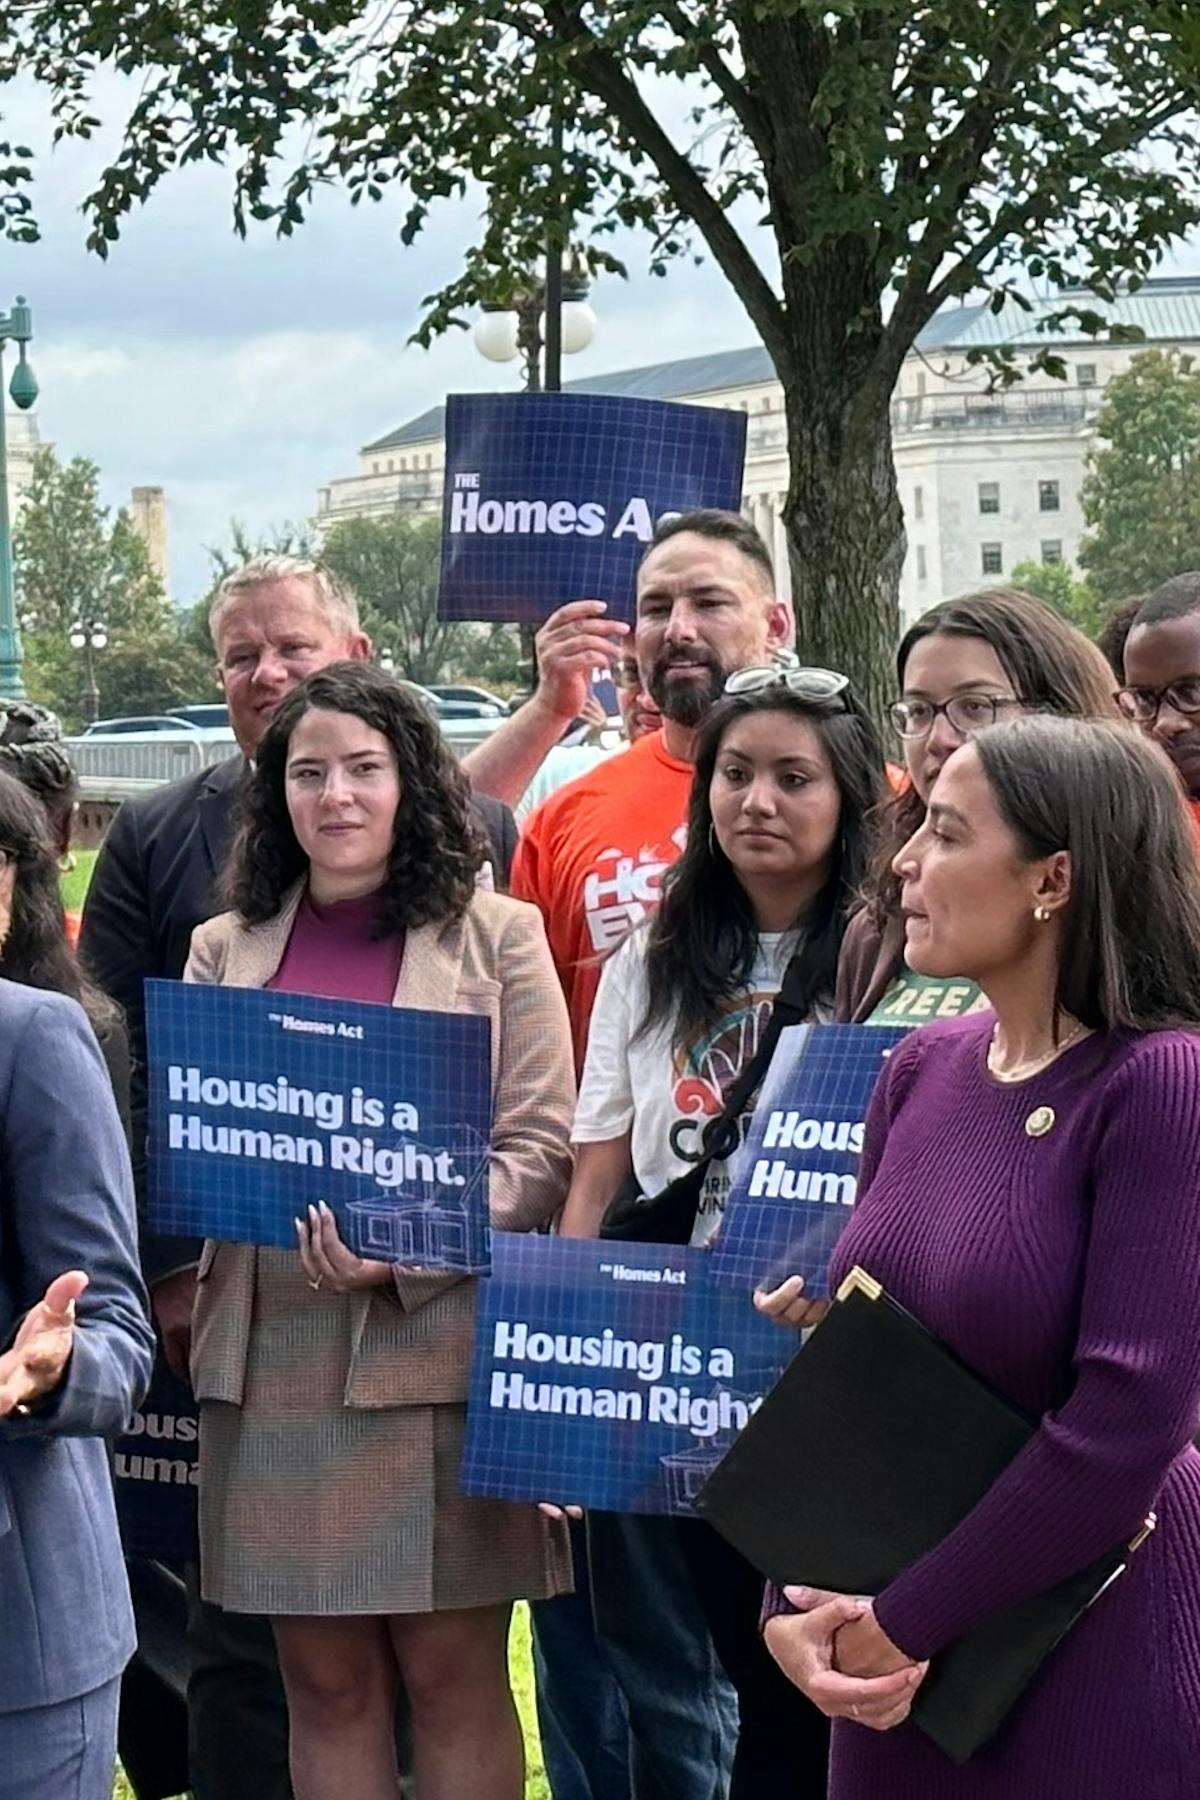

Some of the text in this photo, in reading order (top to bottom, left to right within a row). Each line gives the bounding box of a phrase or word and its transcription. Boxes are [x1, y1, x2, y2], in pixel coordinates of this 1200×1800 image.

[454, 472, 480, 489] THE
[450, 491, 683, 541] Homes A
[884, 979, 970, 1016] REE
[283, 1015, 335, 1035] Homes
[338, 1022, 363, 1039] Act
[168, 1066, 418, 1132] Housing is a
[169, 1114, 466, 1187] Human Right.
[763, 1111, 866, 1154] Hous
[748, 1160, 858, 1205] Hum
[613, 1264, 661, 1283] Homes
[662, 1267, 686, 1285] Act
[493, 1321, 733, 1381] Housing is a
[490, 1371, 642, 1420] Human
